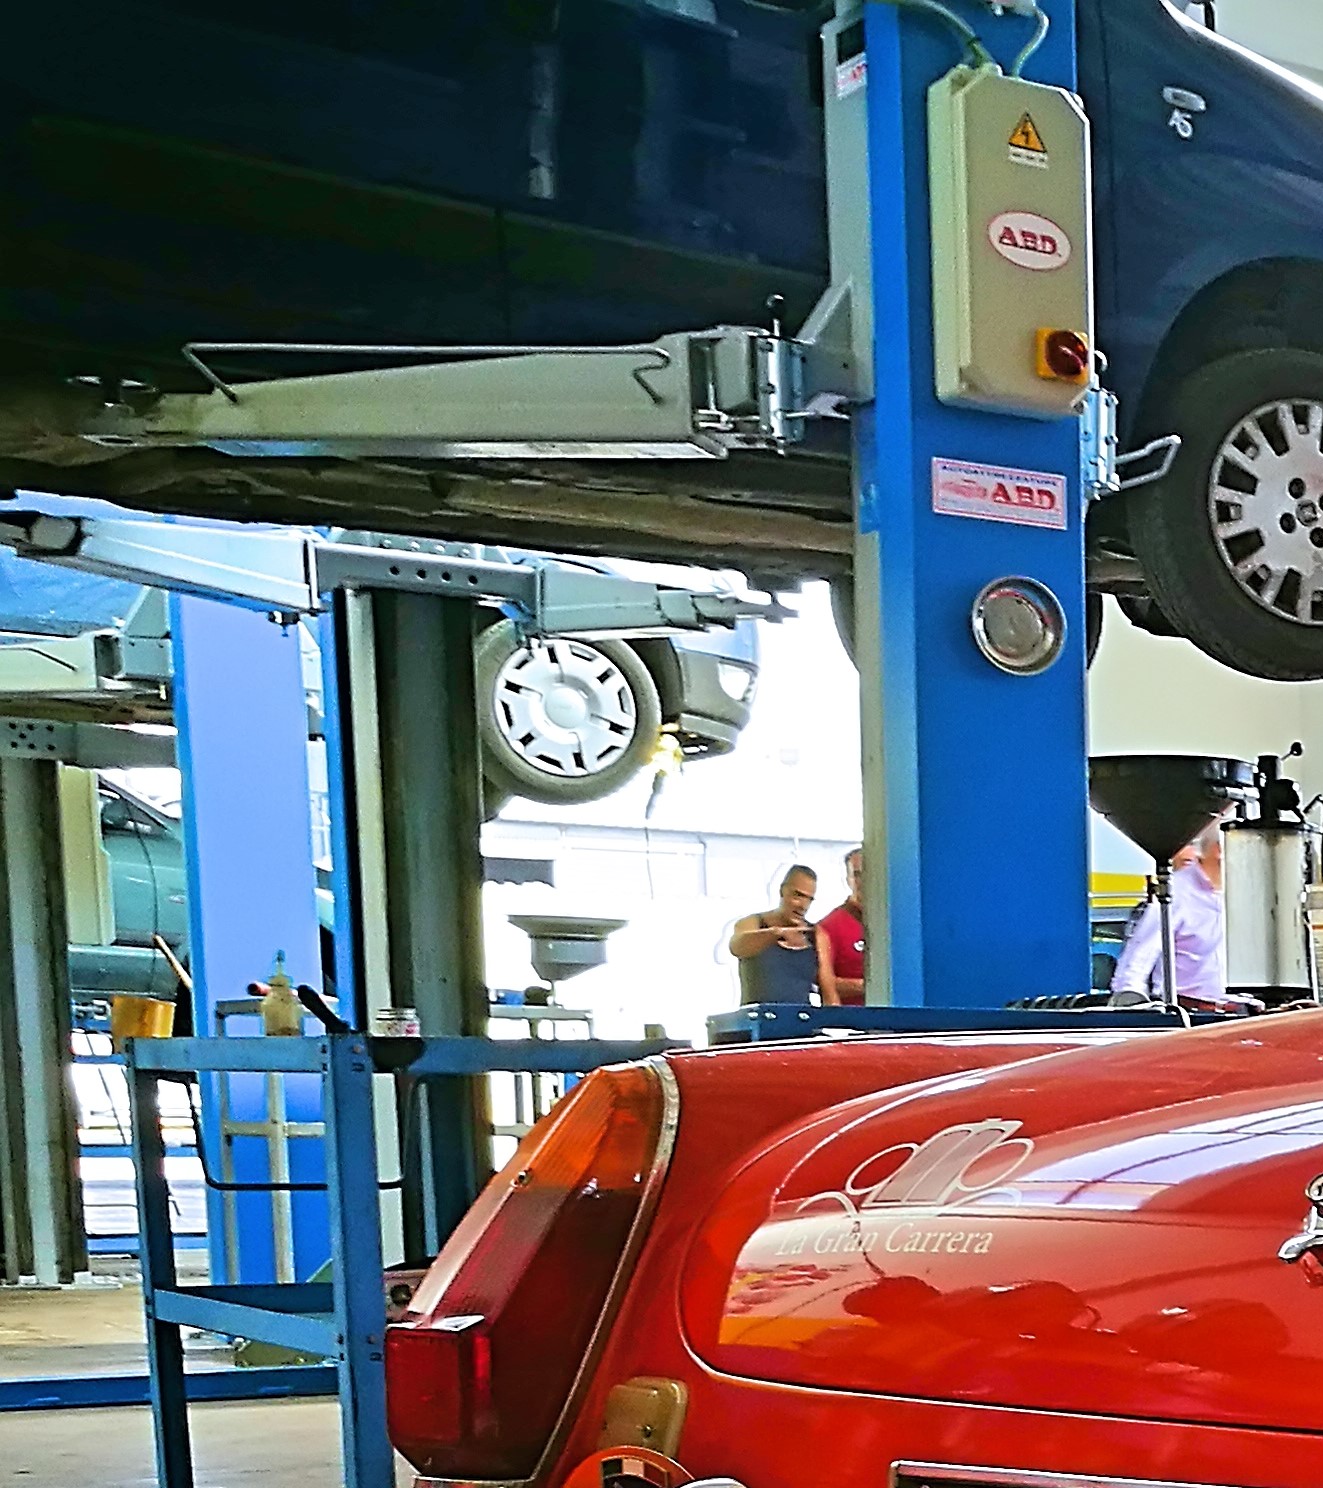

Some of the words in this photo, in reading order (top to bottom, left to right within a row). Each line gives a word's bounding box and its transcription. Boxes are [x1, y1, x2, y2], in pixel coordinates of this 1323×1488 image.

[999, 225, 1057, 255] ABD
[991, 482, 1056, 510] ABD
[774, 1226, 809, 1256] La
[813, 1223, 879, 1254] Gran
[884, 1222, 995, 1255] Carrera
